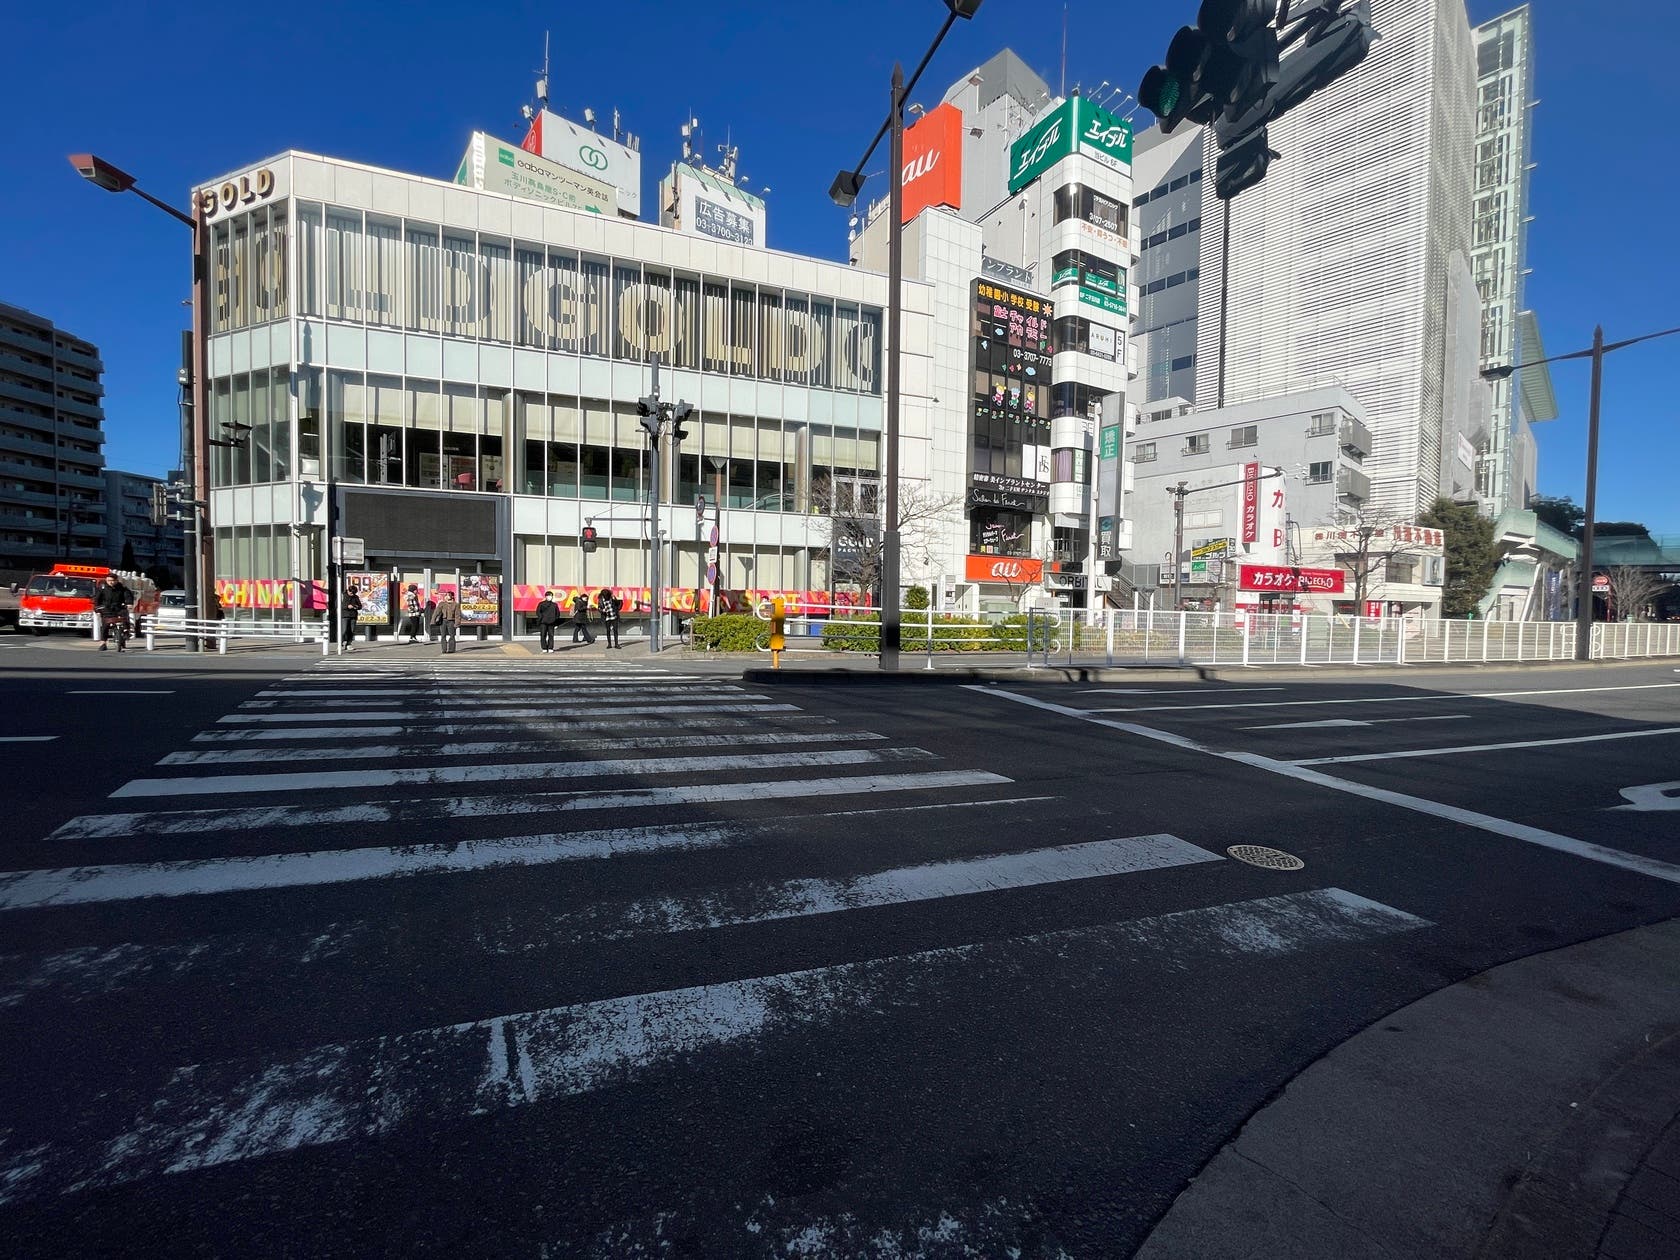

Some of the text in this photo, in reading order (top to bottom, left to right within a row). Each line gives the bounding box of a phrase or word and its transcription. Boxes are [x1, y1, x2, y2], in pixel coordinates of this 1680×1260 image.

[1014, 118, 1063, 180] エイブル
[1084, 119, 1127, 148] エイブル
[902, 148, 941, 186] au
[699, 200, 750, 234] 広告募集
[1245, 505, 1256, 539] カラオケ
[991, 562, 1022, 578] au
[1253, 572, 1295, 586] カラオケ
